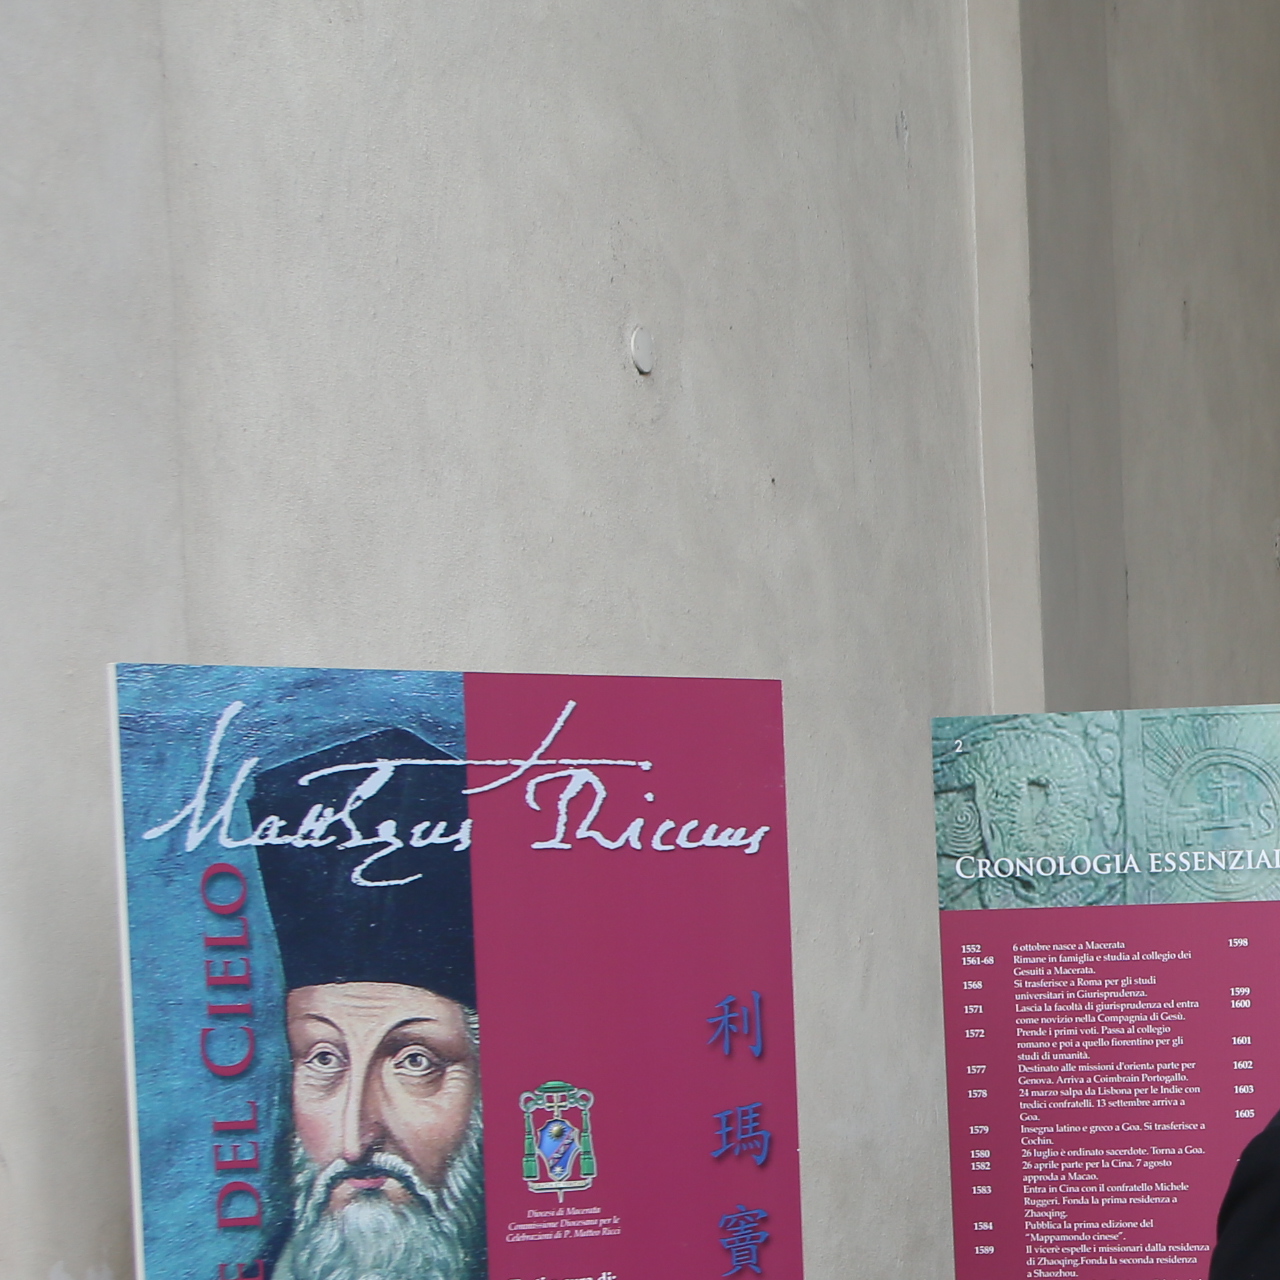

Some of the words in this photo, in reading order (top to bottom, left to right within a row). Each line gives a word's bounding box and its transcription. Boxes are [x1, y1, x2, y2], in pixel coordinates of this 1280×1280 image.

[954, 739, 963, 753] 2
[955, 854, 1141, 879] CRONOLOGIA
[1012, 943, 1018, 951] 6
[1019, 942, 1050, 951] ottobre
[1086, 941, 1124, 949] Macerata
[1228, 938, 1248, 946] 1598
[961, 944, 980, 952] 1552
[962, 956, 994, 964] 1561-68
[1014, 955, 1046, 963] Rimane
[1048, 954, 1056, 962] in
[1059, 953, 1094, 963] famiglia
[1103, 952, 1130, 960] studia
[1132, 951, 1139, 960] al
[1142, 951, 1176, 961] collegio
[1177, 950, 1191, 958] dei
[200, 862, 256, 1077] CIELO
[963, 980, 982, 989] 1568
[1231, 999, 1250, 1007] 1600
[964, 1005, 982, 1013] 1571
[967, 1065, 986, 1073] 1577
[968, 1089, 987, 1097] 1578
[216, 1099, 264, 1230] DEL
[974, 1221, 992, 1229] 1584
